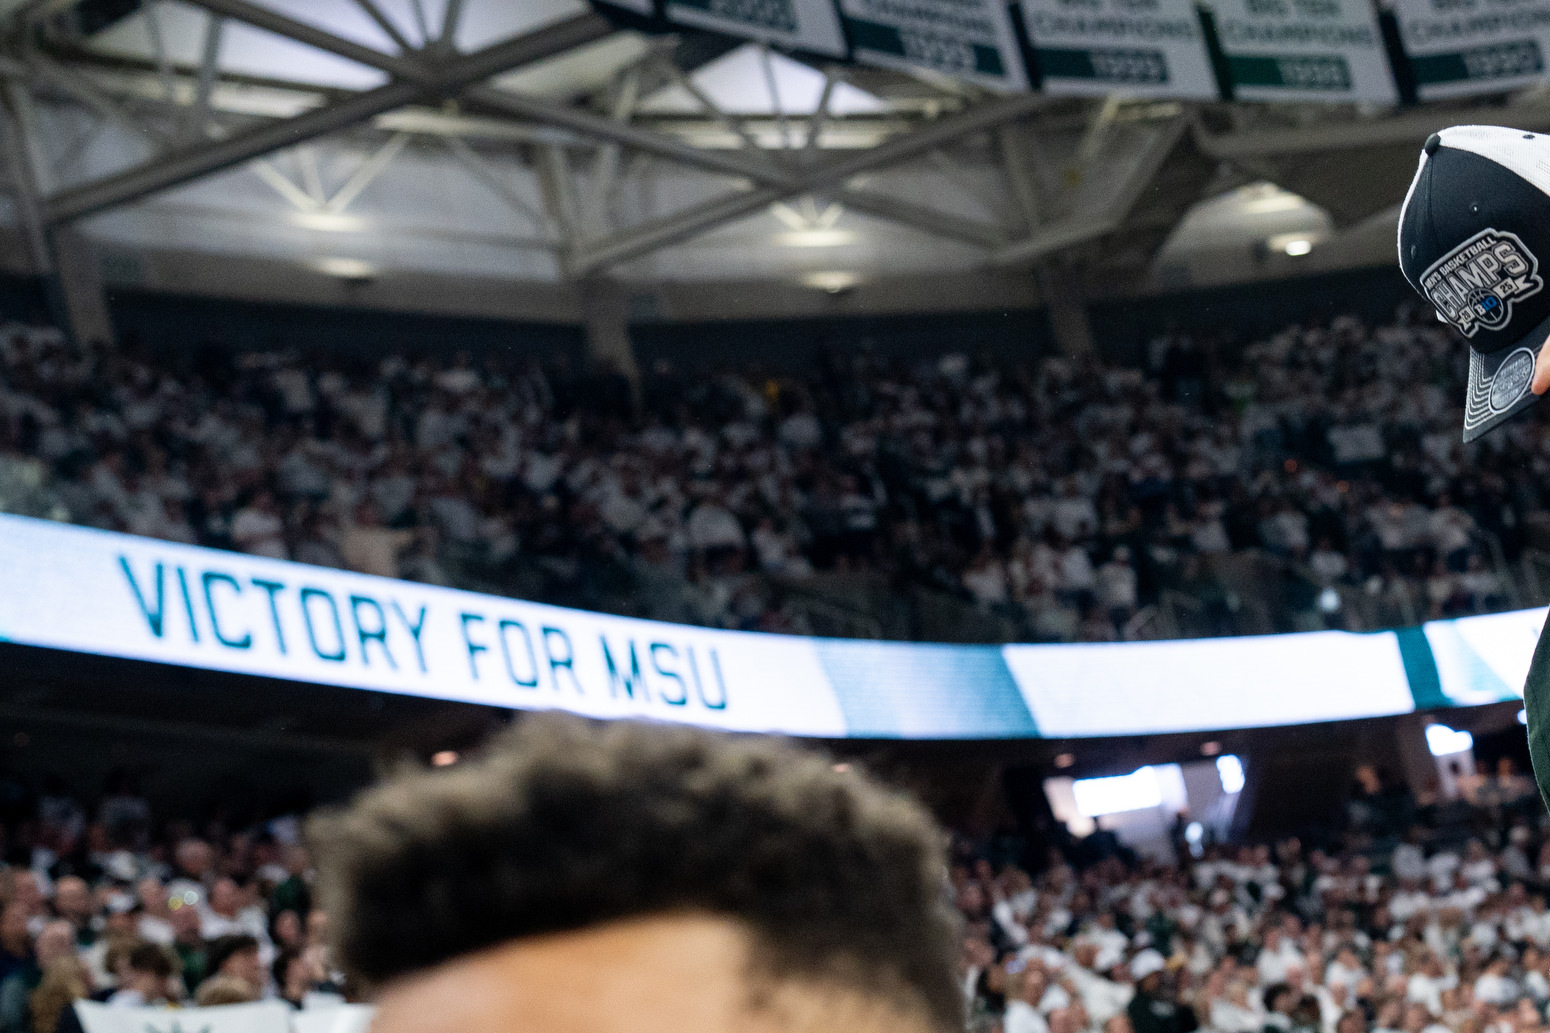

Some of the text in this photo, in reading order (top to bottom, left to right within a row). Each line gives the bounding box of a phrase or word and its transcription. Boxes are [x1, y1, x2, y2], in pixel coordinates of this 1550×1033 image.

[1424, 236, 1497, 291] MEN'S BASKETBALL
[1431, 240, 1529, 321] CHAMPS
[117, 552, 729, 712] VICTORY FOR MSU
